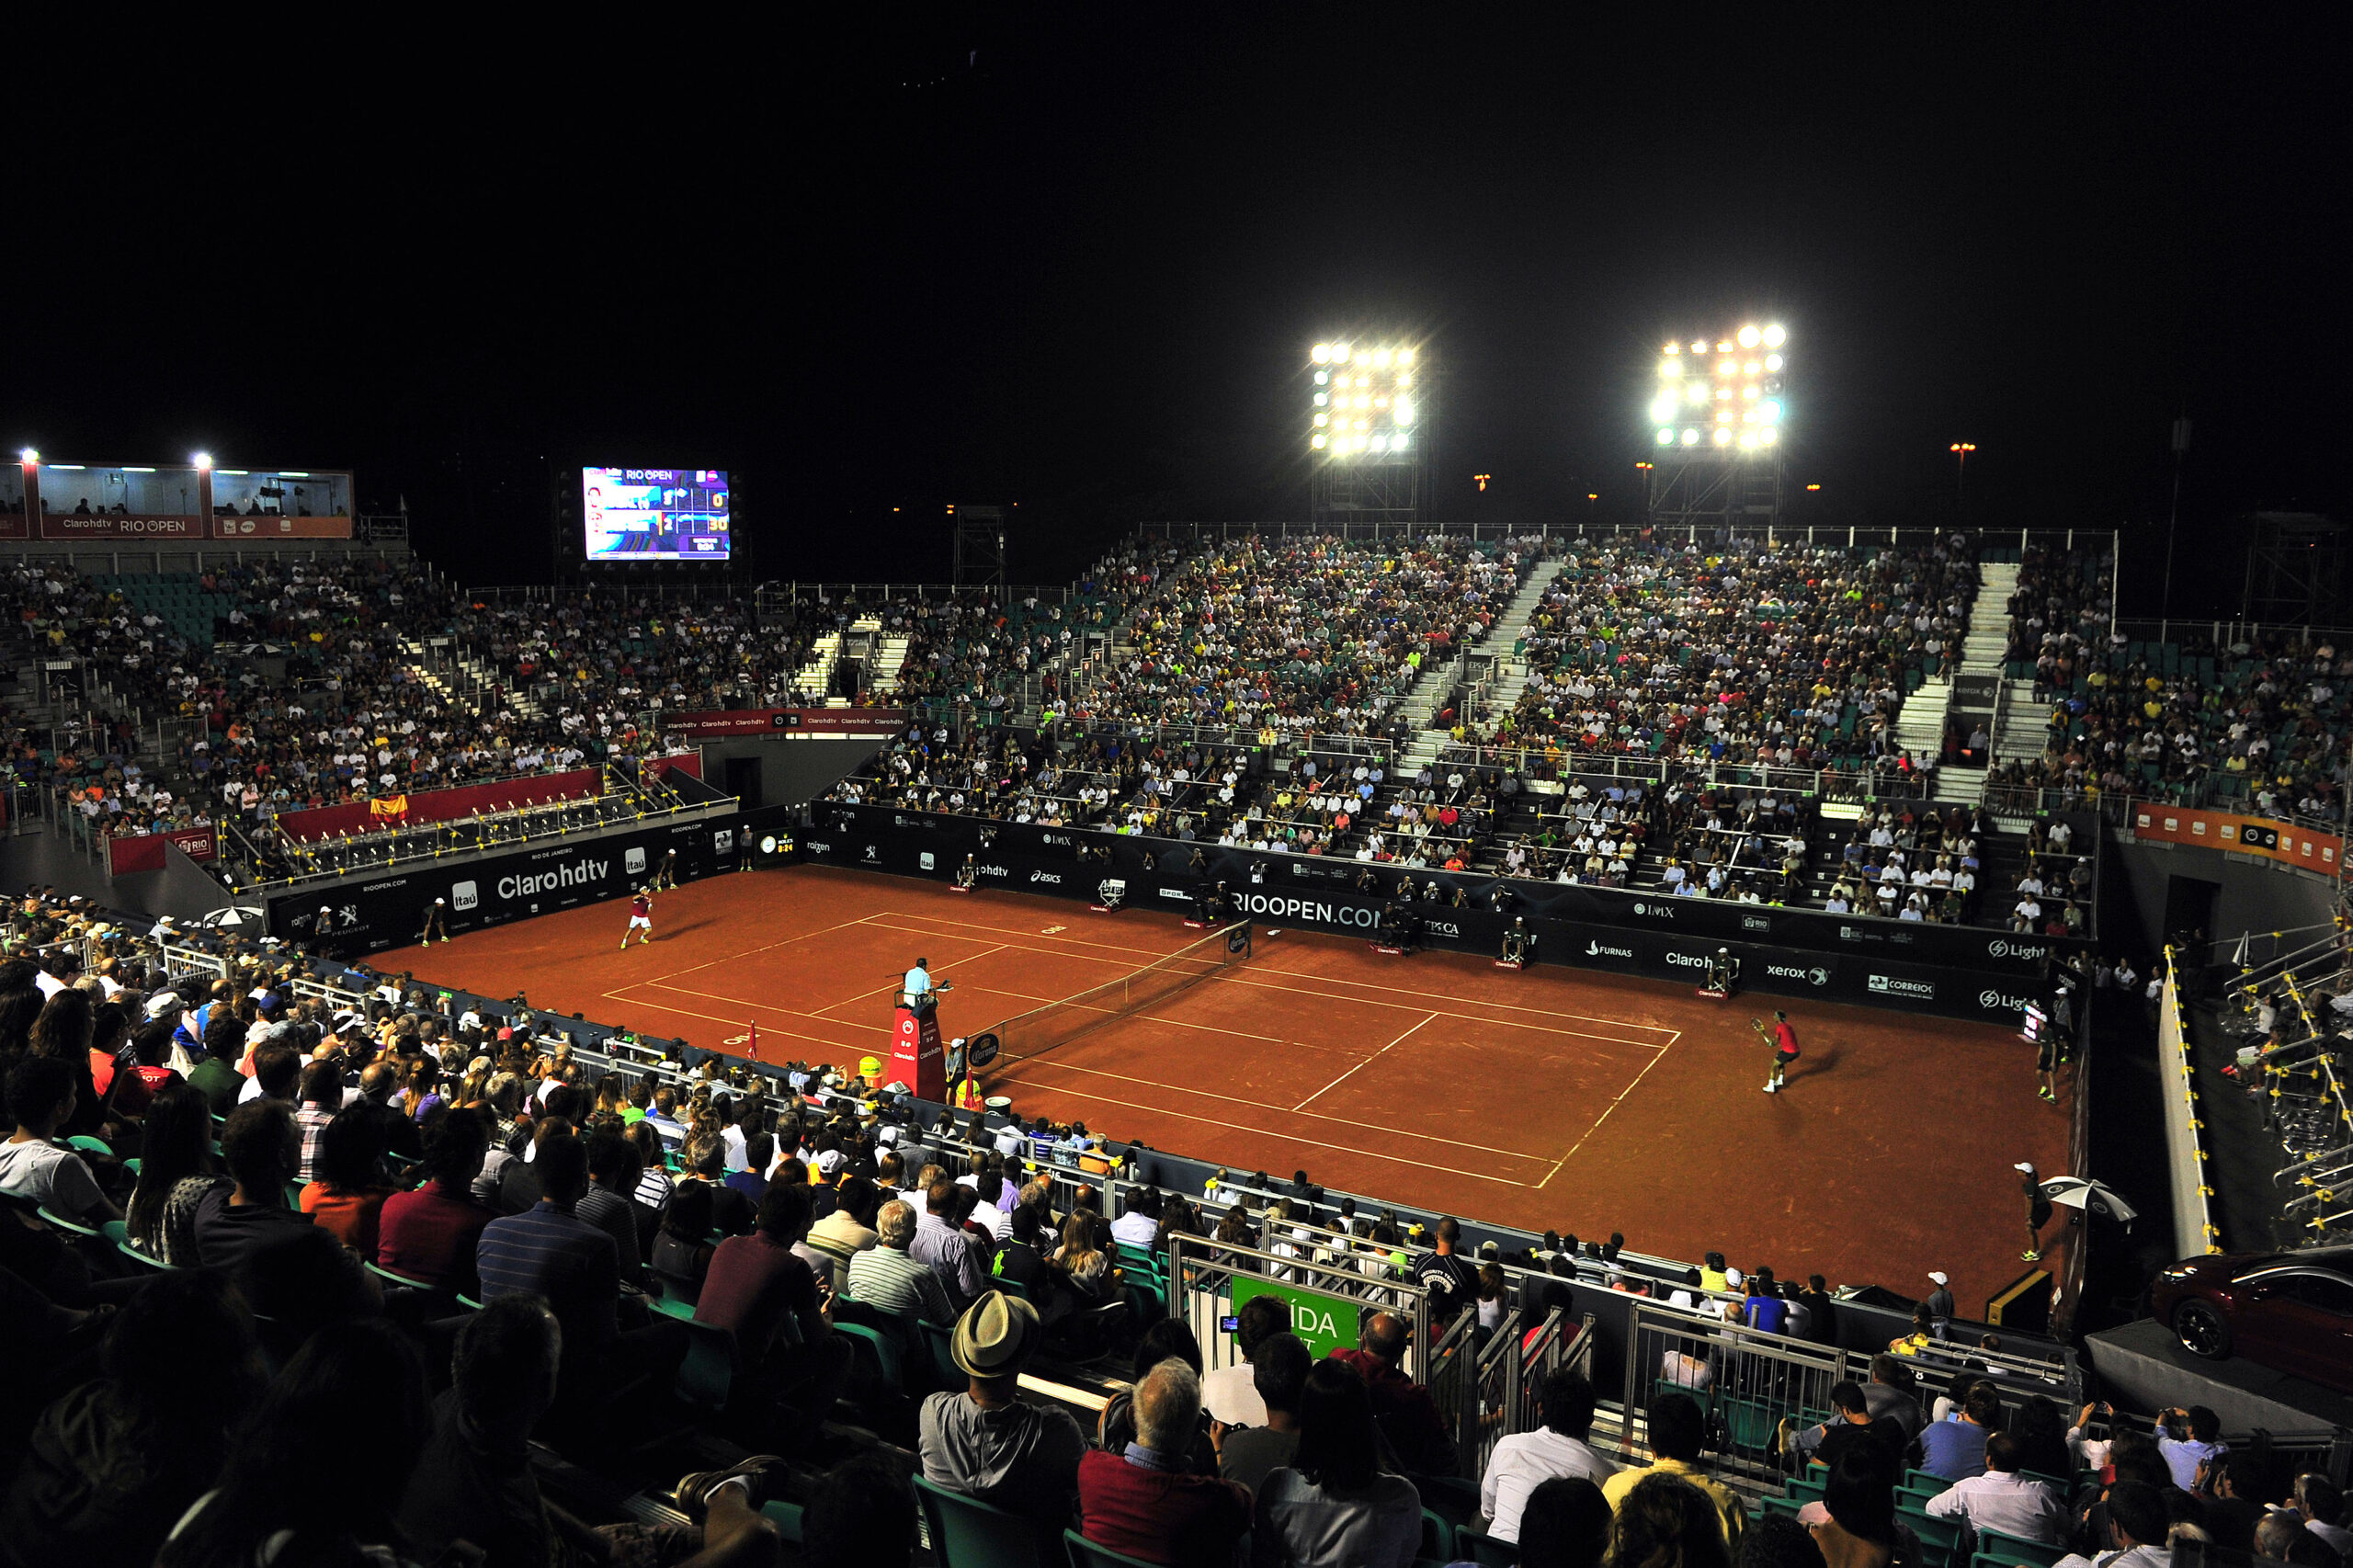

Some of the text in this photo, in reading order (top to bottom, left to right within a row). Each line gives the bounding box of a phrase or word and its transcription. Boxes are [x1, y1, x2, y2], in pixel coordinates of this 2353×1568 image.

[626, 470, 672, 480] RIO OPEN
[712, 494, 723, 507] 0
[120, 520, 144, 531] RIO
[147, 520, 186, 531] OPEN
[664, 517, 673, 530] 2
[709, 517, 728, 530] 30
[192, 839, 207, 849] RIO
[1052, 835, 1071, 846] IMX
[551, 846, 574, 858] JANEIRO
[627, 858, 645, 871] Itaú
[921, 858, 934, 868] Itaú
[363, 879, 407, 892] RIOOPEN.COM
[454, 893, 477, 907] Itaú
[1647, 904, 1675, 918] IMX
[1755, 919, 1768, 928] RIO
[332, 924, 369, 937] PEUGEOT
[1599, 946, 1632, 958] FURNAS
[2010, 943, 2046, 960] Light
[1767, 965, 1806, 979] xerox
[1889, 980, 1933, 994] CORREIOS
[972, 1044, 996, 1064] Corona
[1421, 1269, 1443, 1278] SECURITY
